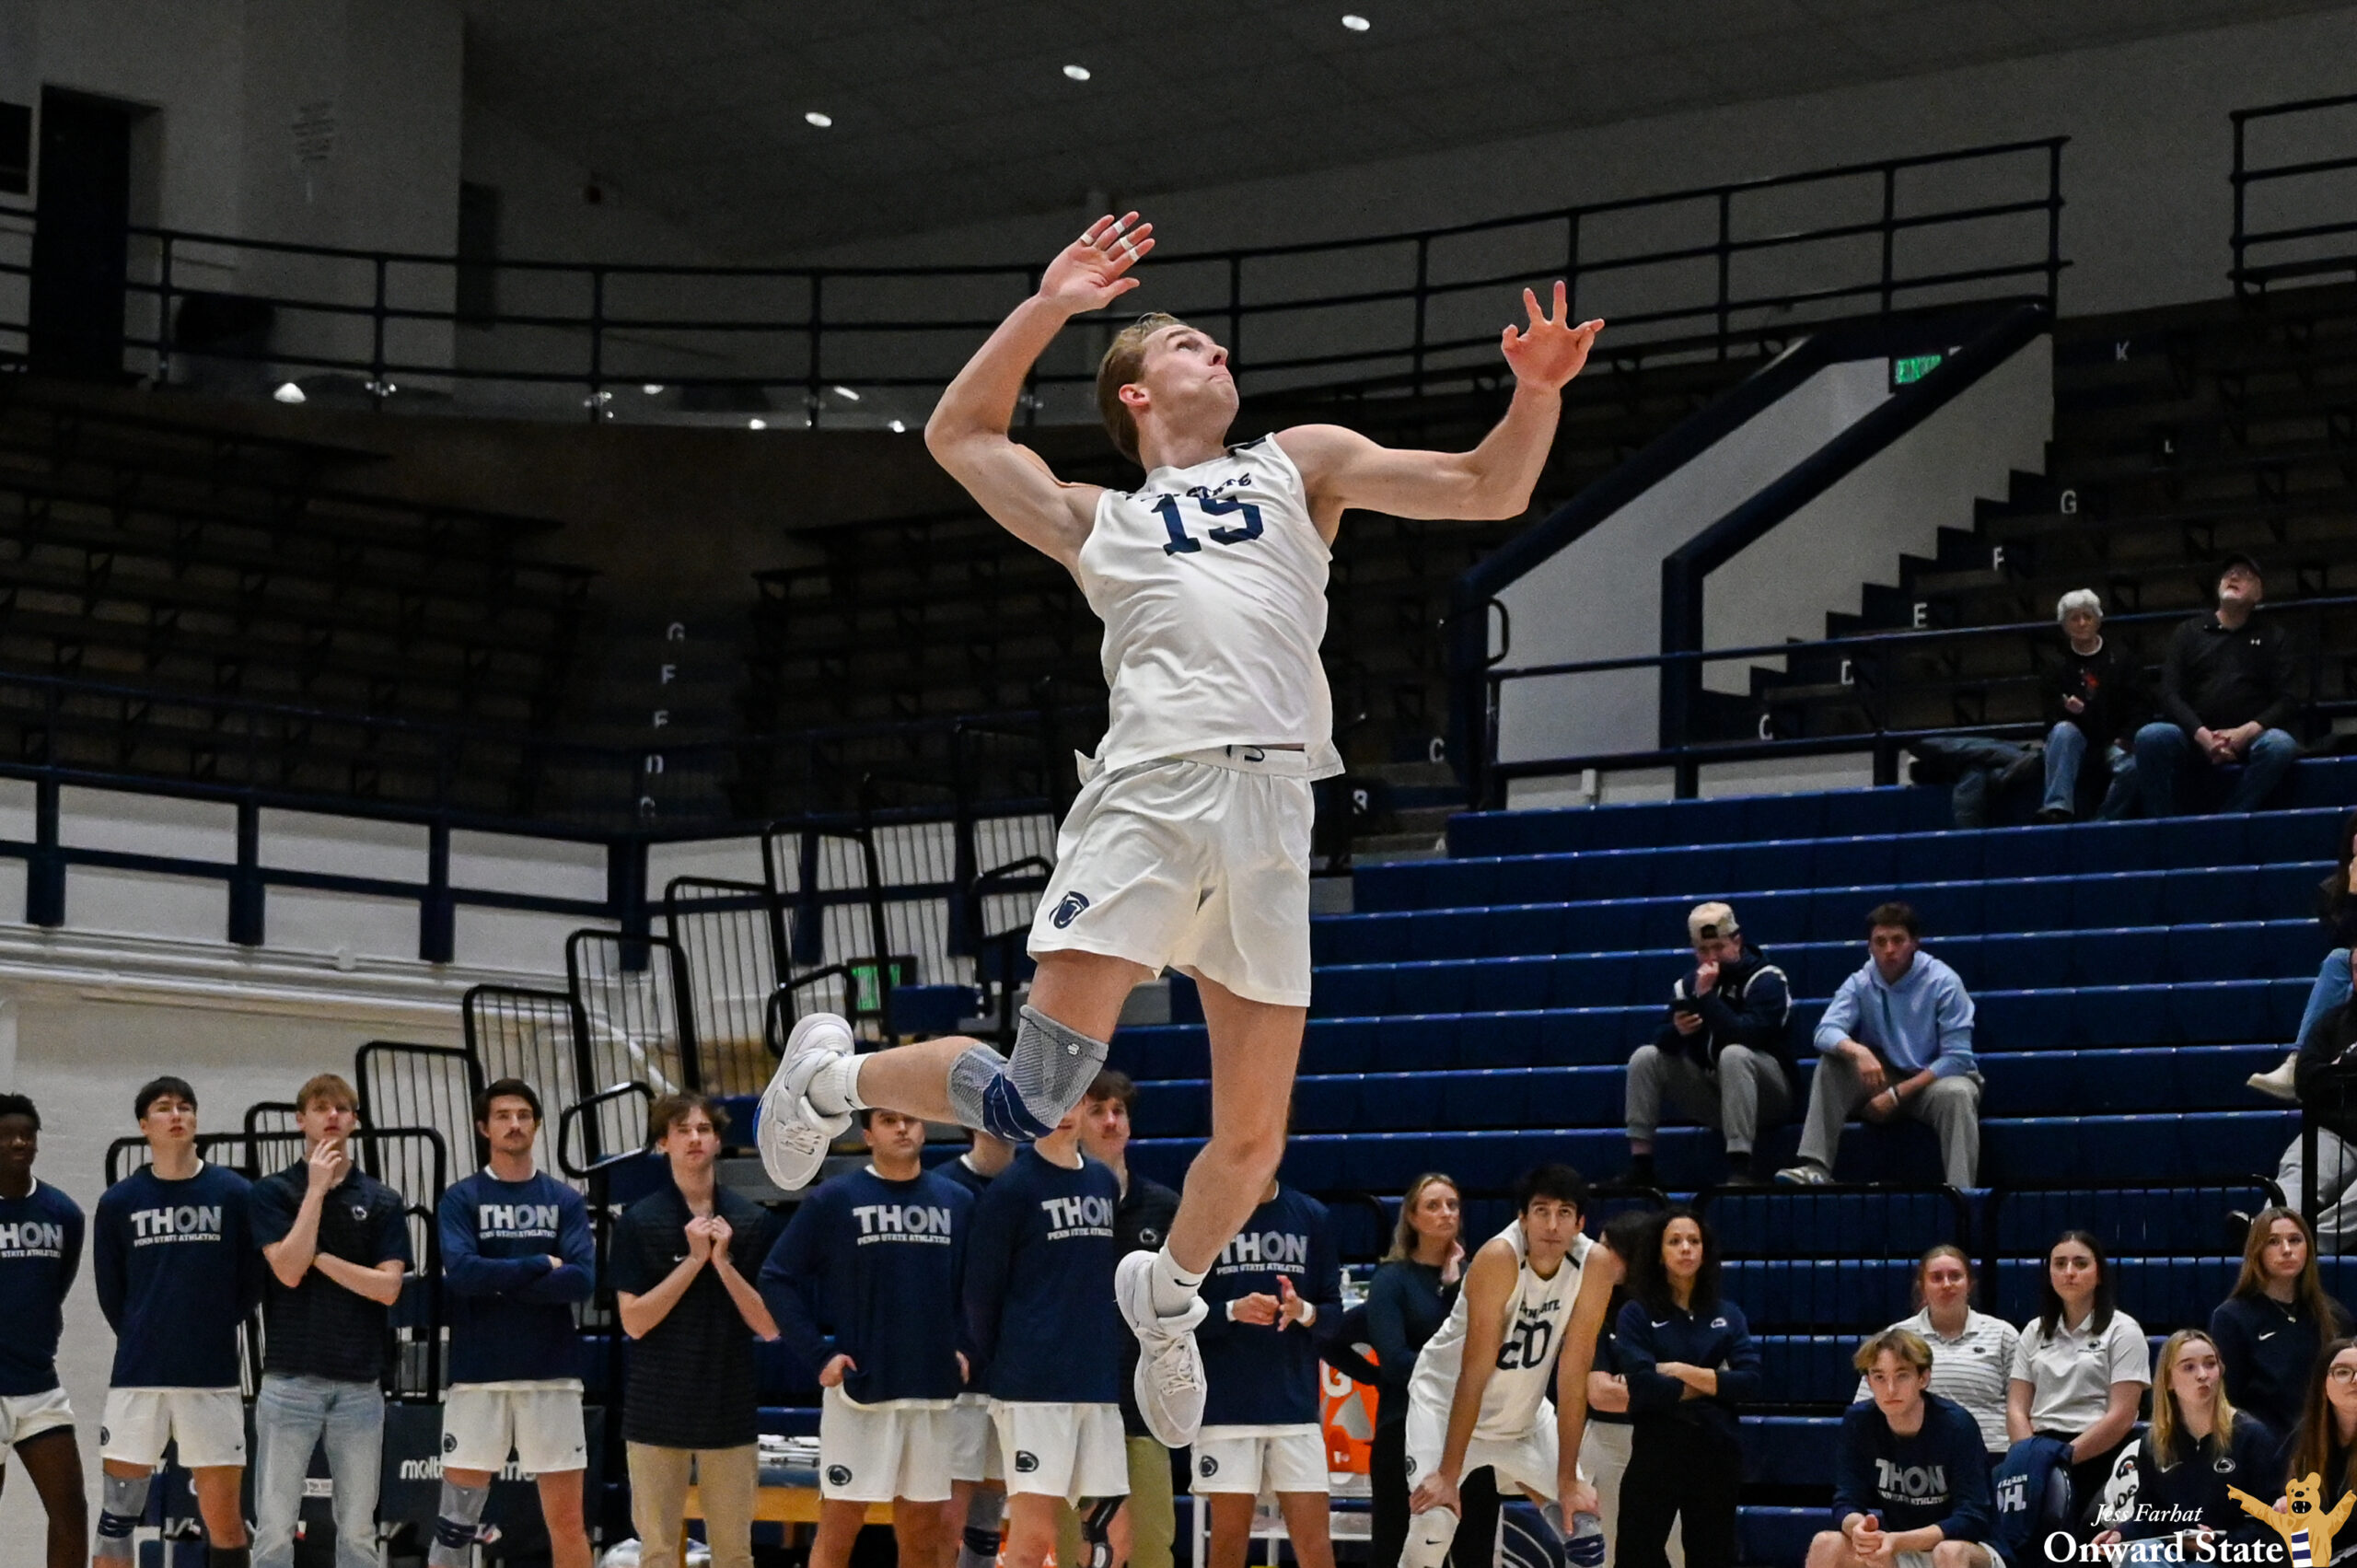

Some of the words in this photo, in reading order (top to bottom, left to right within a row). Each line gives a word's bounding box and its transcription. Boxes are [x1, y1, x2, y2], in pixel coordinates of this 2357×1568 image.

[2060, 490, 2078, 514] G
[1151, 494, 1264, 556] 15
[1992, 546, 2005, 571] F
[1913, 602, 1928, 628] E
[661, 663, 677, 684] F
[1429, 738, 1445, 763] C
[131, 1205, 222, 1237] THON
[479, 1204, 559, 1230] THON
[853, 1204, 951, 1236] THON
[1040, 1195, 1113, 1230] THON
[1496, 1318, 1552, 1370] 20
[1875, 1458, 1949, 1497] THON
